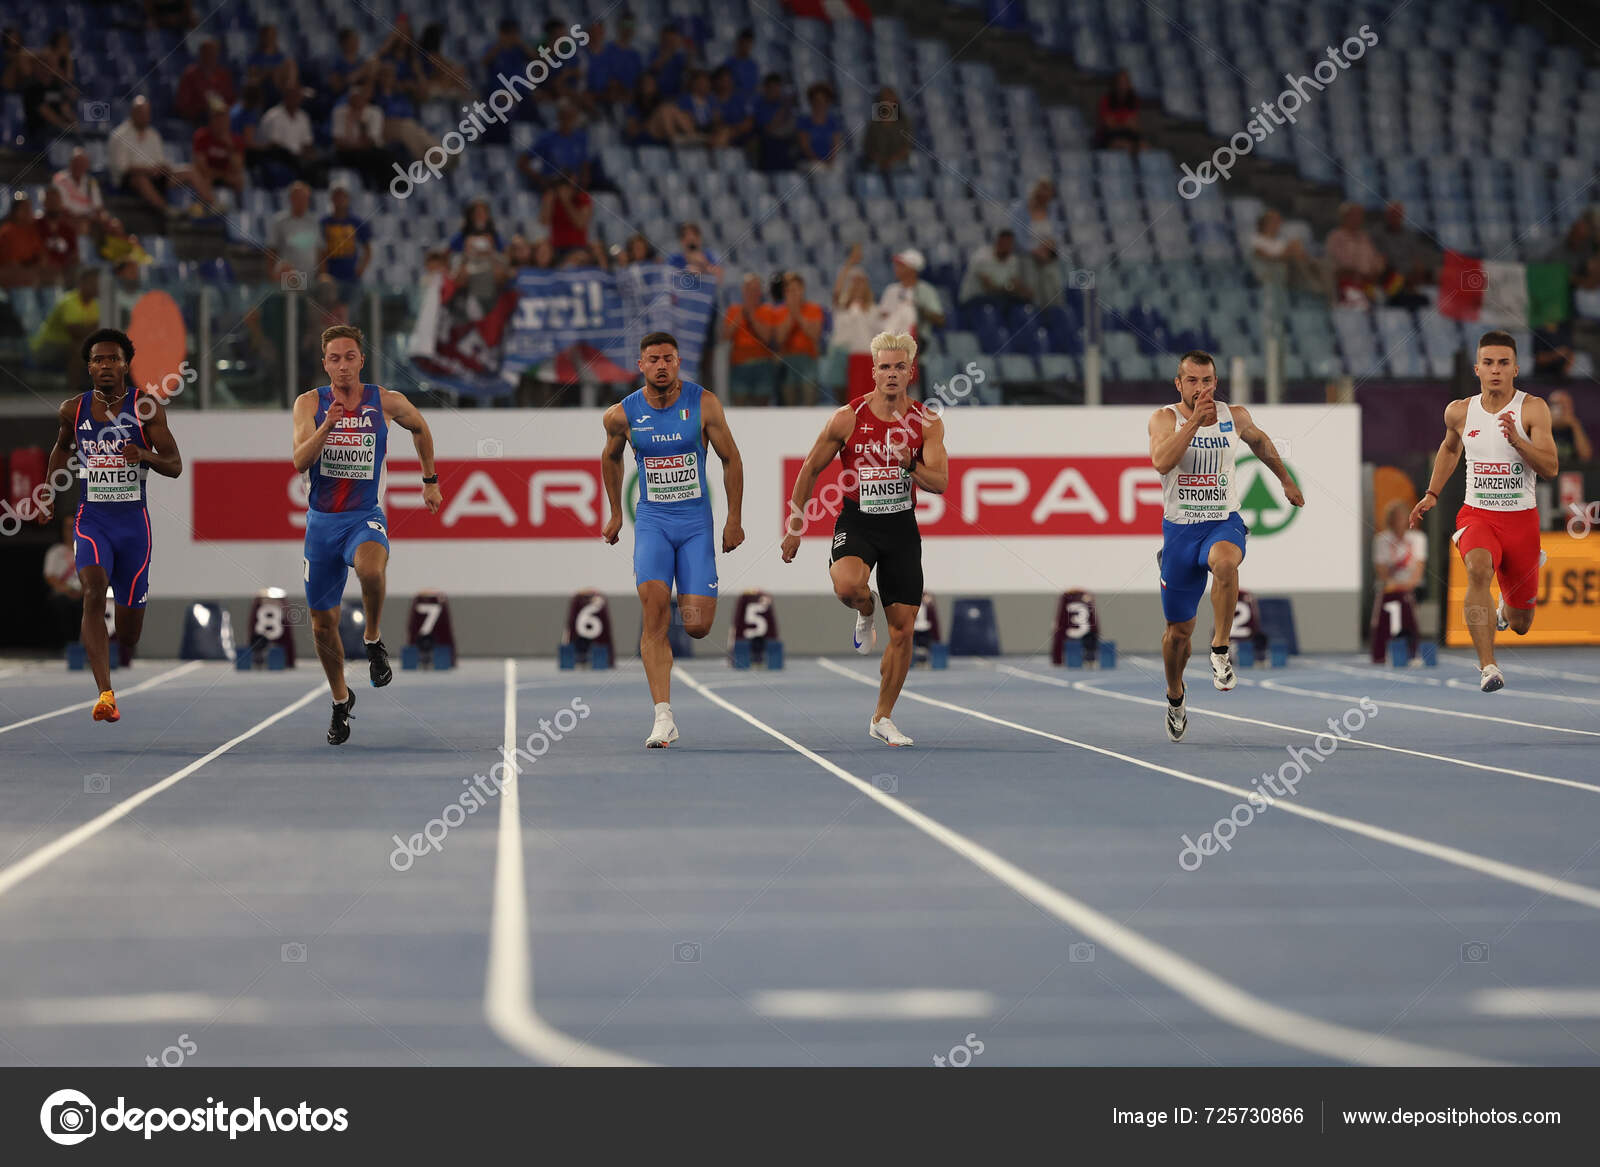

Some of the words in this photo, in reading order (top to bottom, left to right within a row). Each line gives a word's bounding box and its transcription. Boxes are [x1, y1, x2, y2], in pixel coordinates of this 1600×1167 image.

[512, 280, 603, 329] rri!
[334, 416, 373, 429] ERBIA
[327, 435, 361, 445] SPAR
[651, 433, 682, 442] ITALIA
[1189, 436, 1230, 449] ZECHIA
[322, 448, 373, 462] KIJANOVIĆ
[854, 442, 919, 458] DENMK
[89, 457, 124, 467] SPAR
[646, 457, 683, 468] SPAR
[1474, 463, 1509, 474] SPAR
[89, 470, 137, 483] MATEO
[328, 469, 349, 477] ROMA
[647, 468, 696, 484] MELLUZZO
[860, 469, 898, 479] SPAR
[1179, 475, 1216, 485] SPAR
[861, 481, 910, 496] HANSEN
[1473, 477, 1523, 489] ZAKRZEWSKI
[288, 470, 598, 528] AR
[677, 490, 695, 499] 2024
[1178, 487, 1227, 501] STROMŠÍK
[868, 504, 889, 512] ROMA
[891, 503, 906, 511] 2024
[1562, 568, 1600, 606] SE
[255, 604, 284, 640] 8
[416, 602, 442, 636] 7
[575, 600, 603, 639] 6
[743, 602, 769, 639] 5
[1065, 602, 1091, 639] 3
[1229, 600, 1252, 638] 2
[1382, 600, 1403, 637] 1
